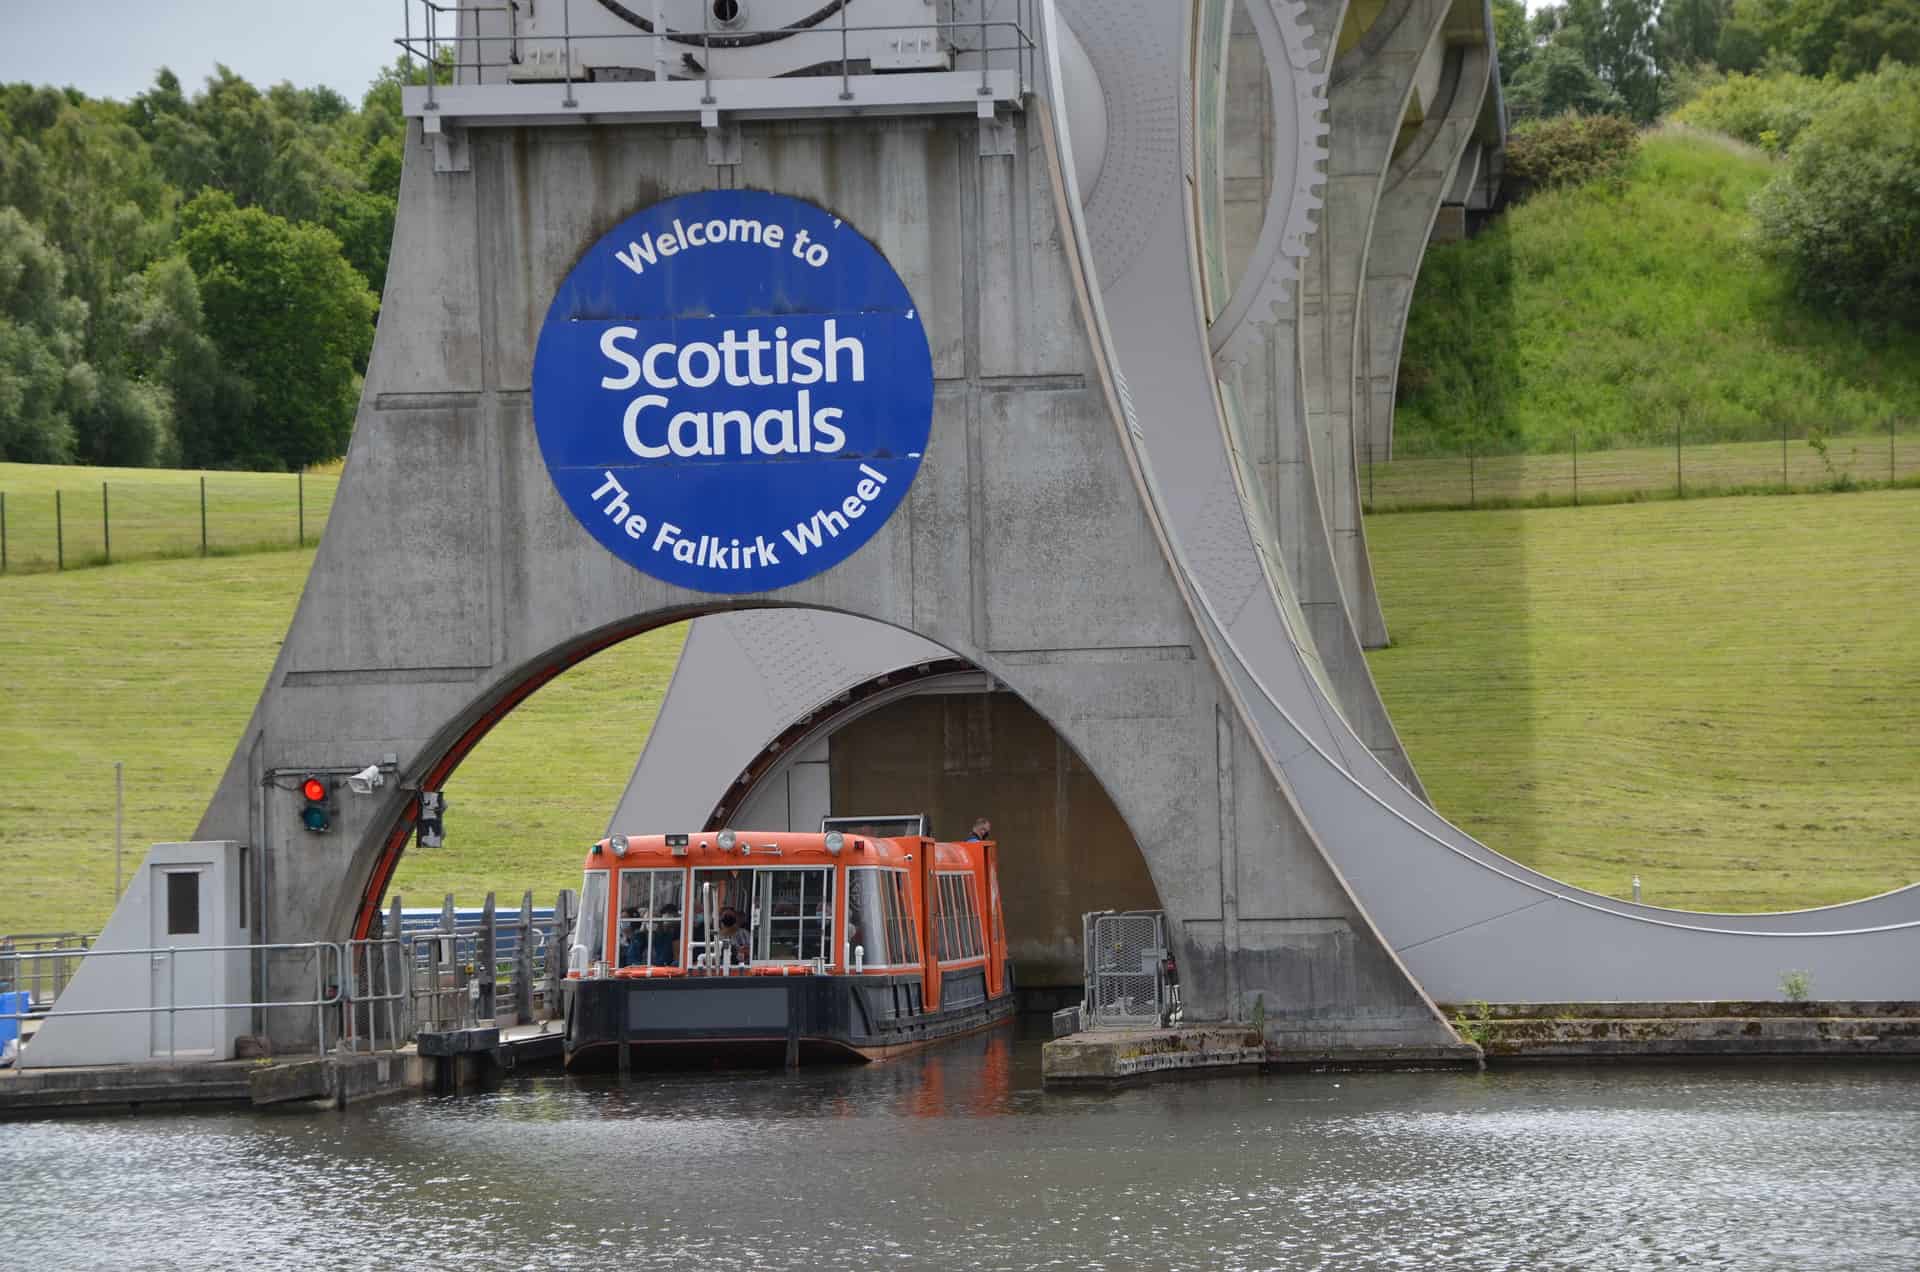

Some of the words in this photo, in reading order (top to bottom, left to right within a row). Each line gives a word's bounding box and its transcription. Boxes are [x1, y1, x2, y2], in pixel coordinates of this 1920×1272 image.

[615, 218, 784, 274] Welcome
[792, 229, 829, 267] to
[599, 318, 865, 390] Scottish
[623, 389, 846, 458] Canals
[591, 470, 647, 540] The
[652, 522, 780, 569] Falkirk
[781, 463, 888, 556] Wheel
